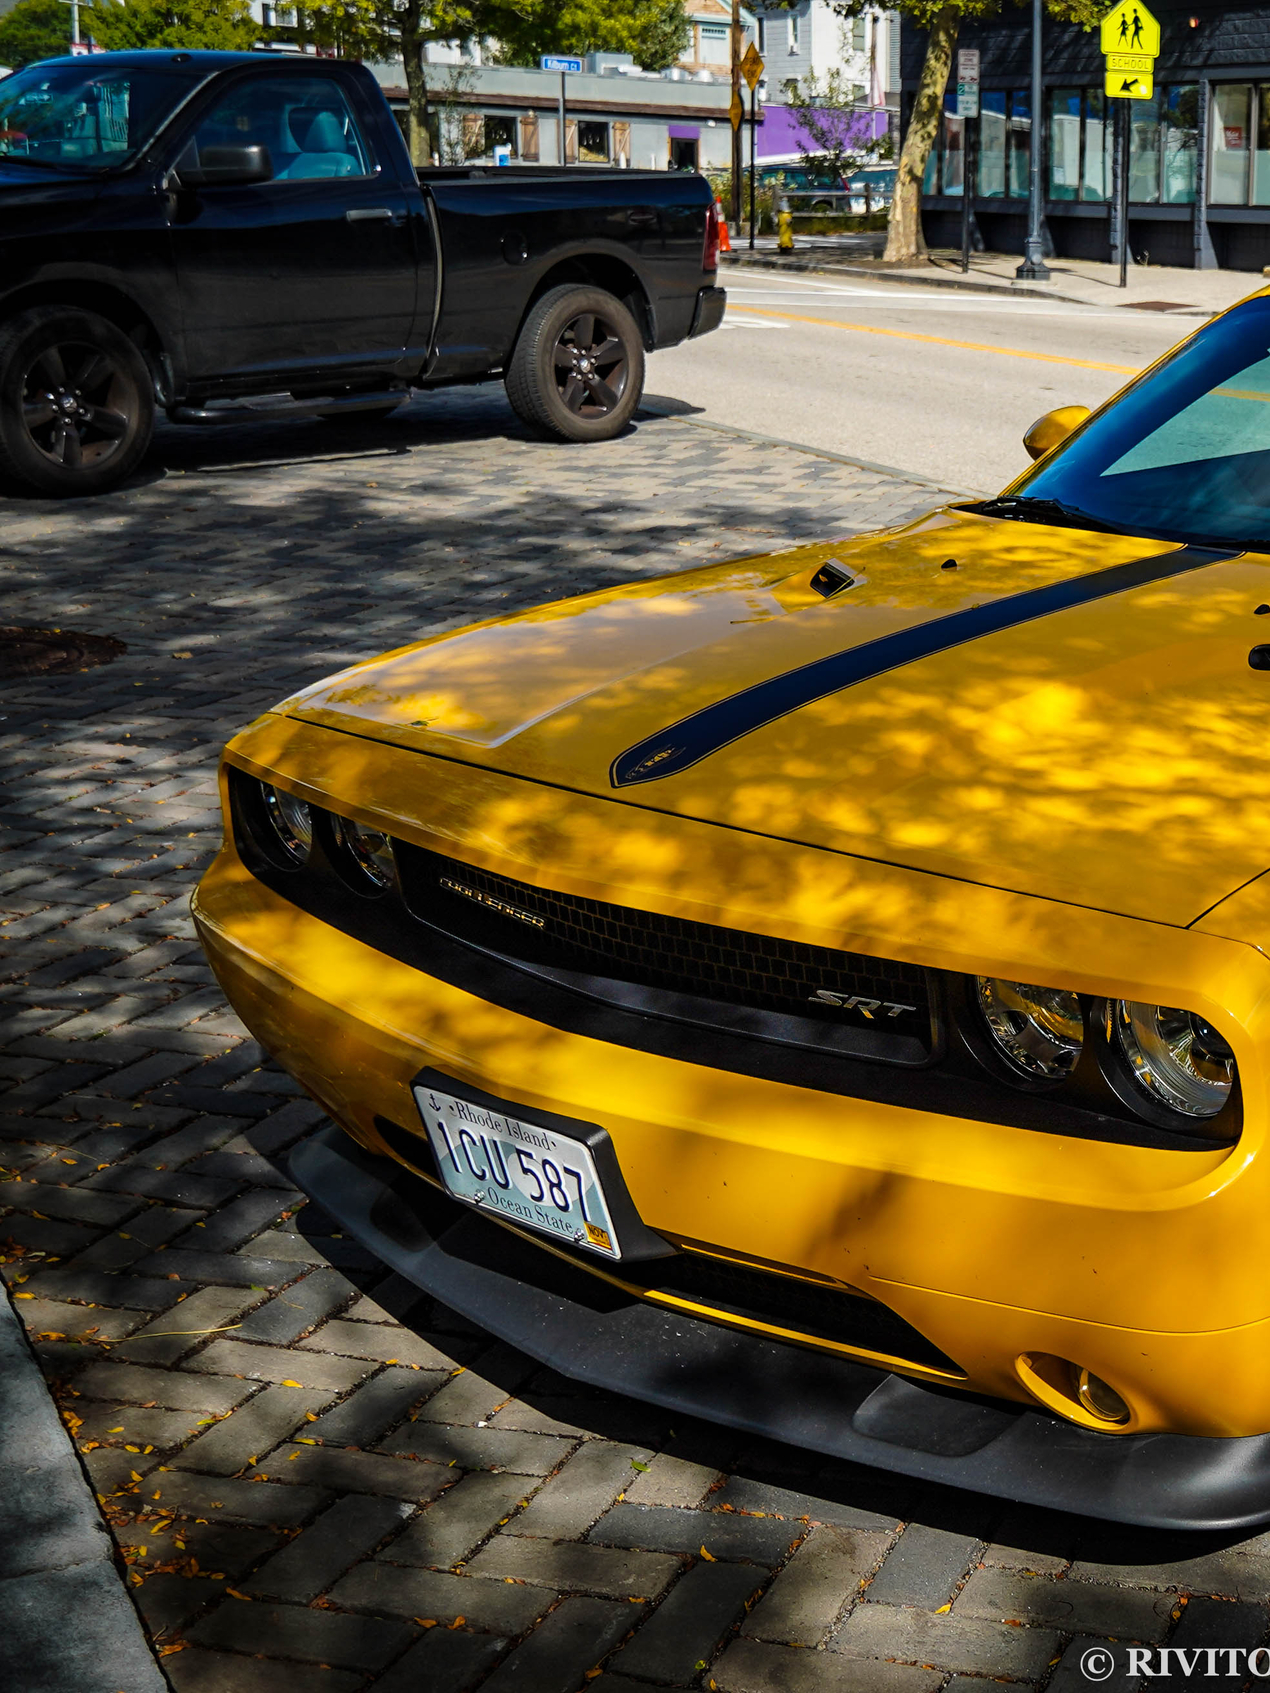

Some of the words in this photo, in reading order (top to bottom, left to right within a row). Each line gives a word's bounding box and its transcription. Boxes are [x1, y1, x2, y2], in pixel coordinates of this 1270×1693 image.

[1111, 58, 1149, 69] SCHOOL
[807, 988, 917, 1020] SRT
[454, 1101, 503, 1133] Rhode
[503, 1117, 552, 1151] Island
[437, 1119, 511, 1190] 1CU
[515, 1147, 590, 1222] 587
[488, 1186, 533, 1218] Ocean
[536, 1204, 574, 1234] State
